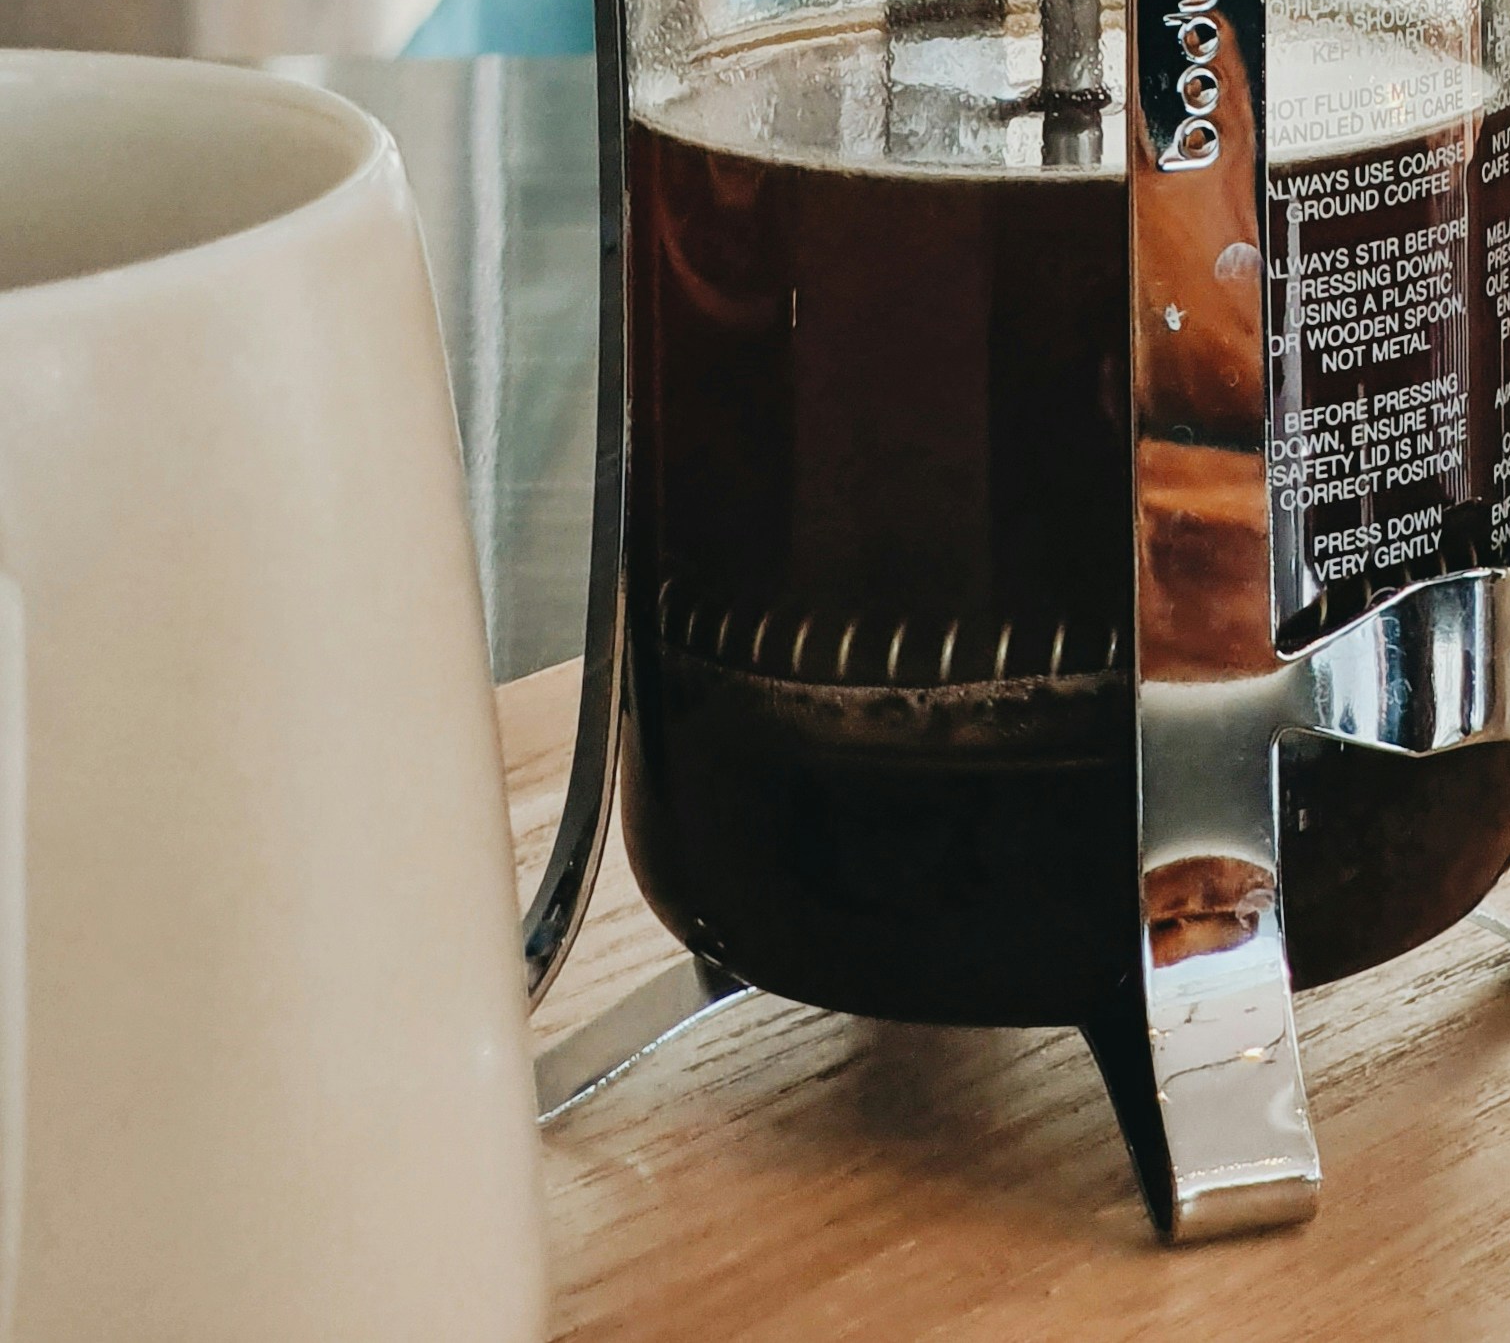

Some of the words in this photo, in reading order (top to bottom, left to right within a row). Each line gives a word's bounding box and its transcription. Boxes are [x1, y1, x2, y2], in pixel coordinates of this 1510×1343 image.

[1315, 84, 1385, 116] FLUIDS
[1391, 71, 1439, 100] MUST
[1443, 66, 1463, 89] BE
[1370, 105, 1417, 131] WITH
[1422, 90, 1464, 119] CARE
[1267, 170, 1349, 201] ALWAYS
[1355, 159, 1394, 187] USE
[1399, 141, 1465, 178] COARSE
[1482, 153, 1510, 183] CAFE
[1286, 189, 1379, 224] GROUND
[1384, 170, 1451, 206] COFFEE
[1355, 237, 1400, 265] STIR
[1405, 217, 1468, 255] BEFORE
[1286, 264, 1391, 303] PRESSING
[1397, 248, 1453, 282] DOWN,
[1290, 297, 1357, 328] USING
[1363, 293, 1377, 315] A
[1382, 272, 1452, 311] PLASTIC
[1486, 267, 1510, 297] QUE
[1270, 333, 1300, 357] OR
[1306, 312, 1399, 351] WOODEN
[1322, 345, 1366, 374] NOT
[1372, 330, 1431, 363] METAL
[1271, 430, 1345, 461] DOWN,
[1351, 408, 1426, 446] ENSURE
[1430, 392, 1468, 423] THAT
[1284, 397, 1368, 433] BEFORE
[1374, 373, 1458, 416] PRESSING
[1272, 451, 1354, 487] SAFETY
[1360, 444, 1390, 471] LID
[1395, 438, 1411, 461] IS
[1417, 431, 1433, 455] IN
[1438, 418, 1467, 447] THE
[1280, 471, 1381, 511] CORRECT
[1386, 445, 1463, 490] POSITION
[1314, 522, 1382, 557] PRESS
[1388, 504, 1442, 540] DOWN
[1314, 551, 1369, 582] VERY
[1374, 529, 1442, 569] GENTLY
